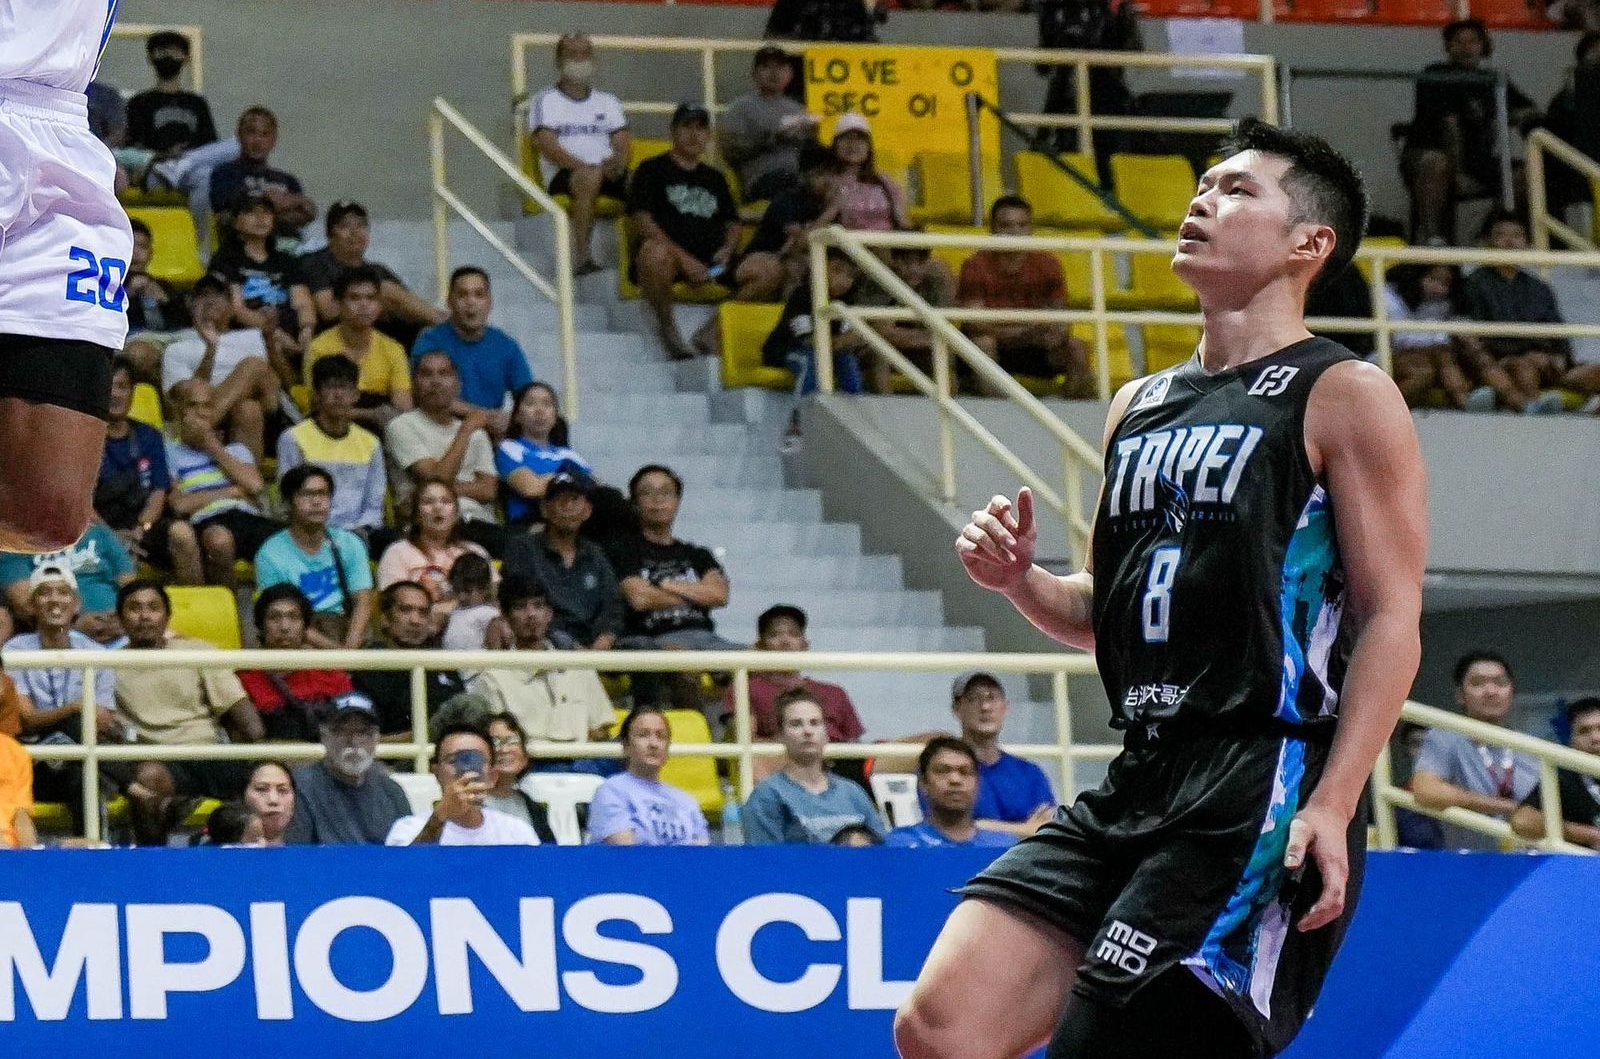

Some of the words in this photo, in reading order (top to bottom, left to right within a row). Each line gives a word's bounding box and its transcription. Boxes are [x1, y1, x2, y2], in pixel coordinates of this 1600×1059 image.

[66, 245, 127, 313] 20
[1109, 423, 1264, 518] TAIPEI
[1141, 544, 1183, 644] 8
[715, 891, 918, 1012] CL
